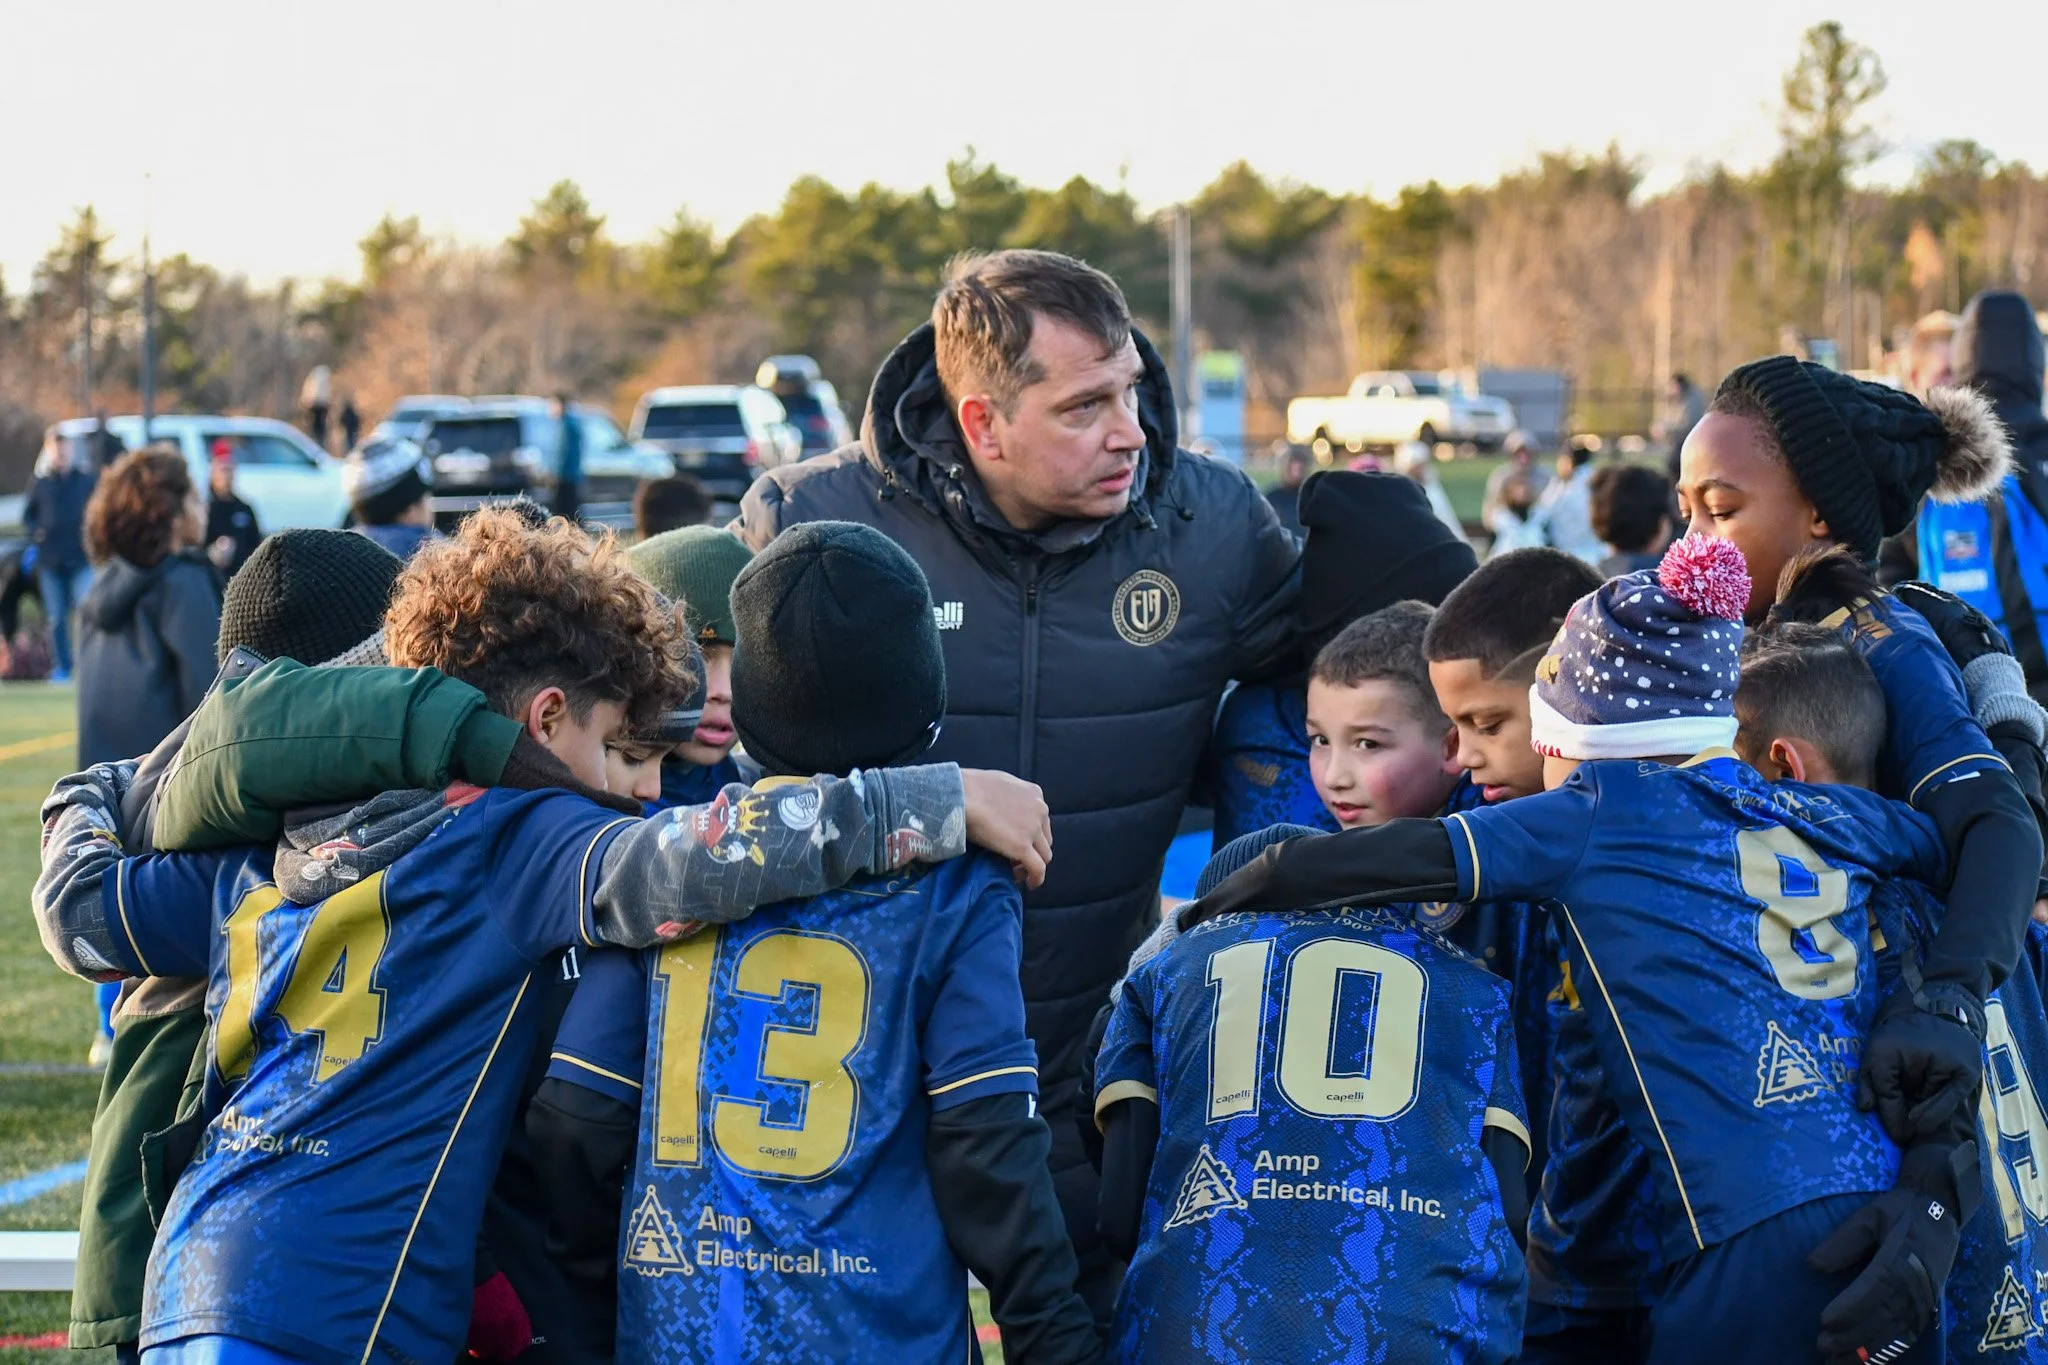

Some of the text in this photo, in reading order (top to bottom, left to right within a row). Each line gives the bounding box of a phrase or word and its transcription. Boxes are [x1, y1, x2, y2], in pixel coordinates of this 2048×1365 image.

[933, 601, 963, 621] elli
[1730, 822, 1861, 1001] 8
[213, 864, 392, 1087] 14
[1205, 936, 1430, 1126] 10
[652, 922, 872, 1184] 13
[1216, 1089, 1251, 1104] capelli
[1326, 1092, 1364, 1102] capelli
[660, 1135, 695, 1146] capelli
[758, 1145, 797, 1157] capelli
[1253, 1150, 1320, 1177] Amp
[1252, 1178, 1446, 1219] Electrical, Inc.
[697, 1205, 751, 1242] Amp
[696, 1240, 878, 1277] Electrical, Inc.
